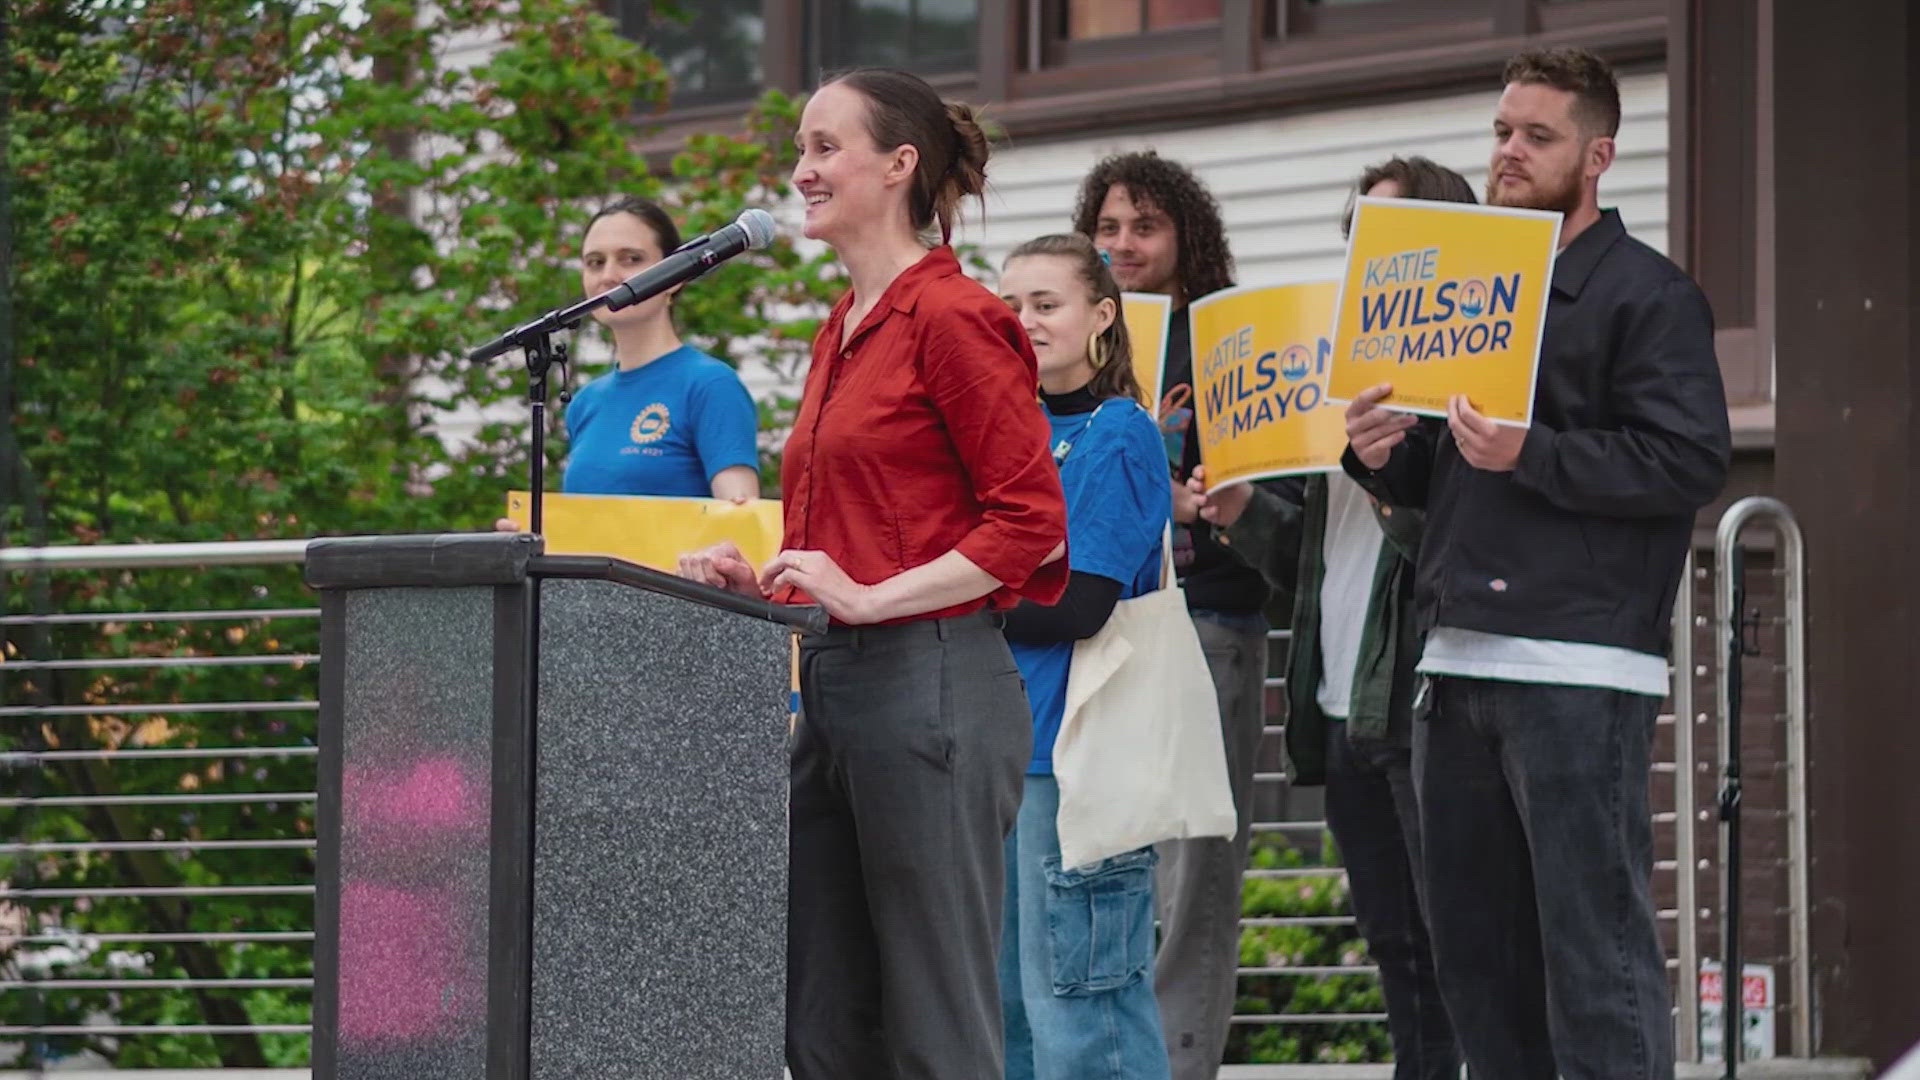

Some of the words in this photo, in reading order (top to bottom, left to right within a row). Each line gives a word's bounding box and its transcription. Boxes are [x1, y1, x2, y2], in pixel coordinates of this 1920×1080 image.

[1364, 247, 1438, 289] KATIE
[1361, 273, 1521, 333] WILSON
[1203, 325, 1253, 381] KATIE
[1352, 335, 1396, 362] FOR
[1398, 320, 1512, 364] MAYOR
[1208, 416, 1229, 445] FOR
[1232, 383, 1329, 440] MAYO
